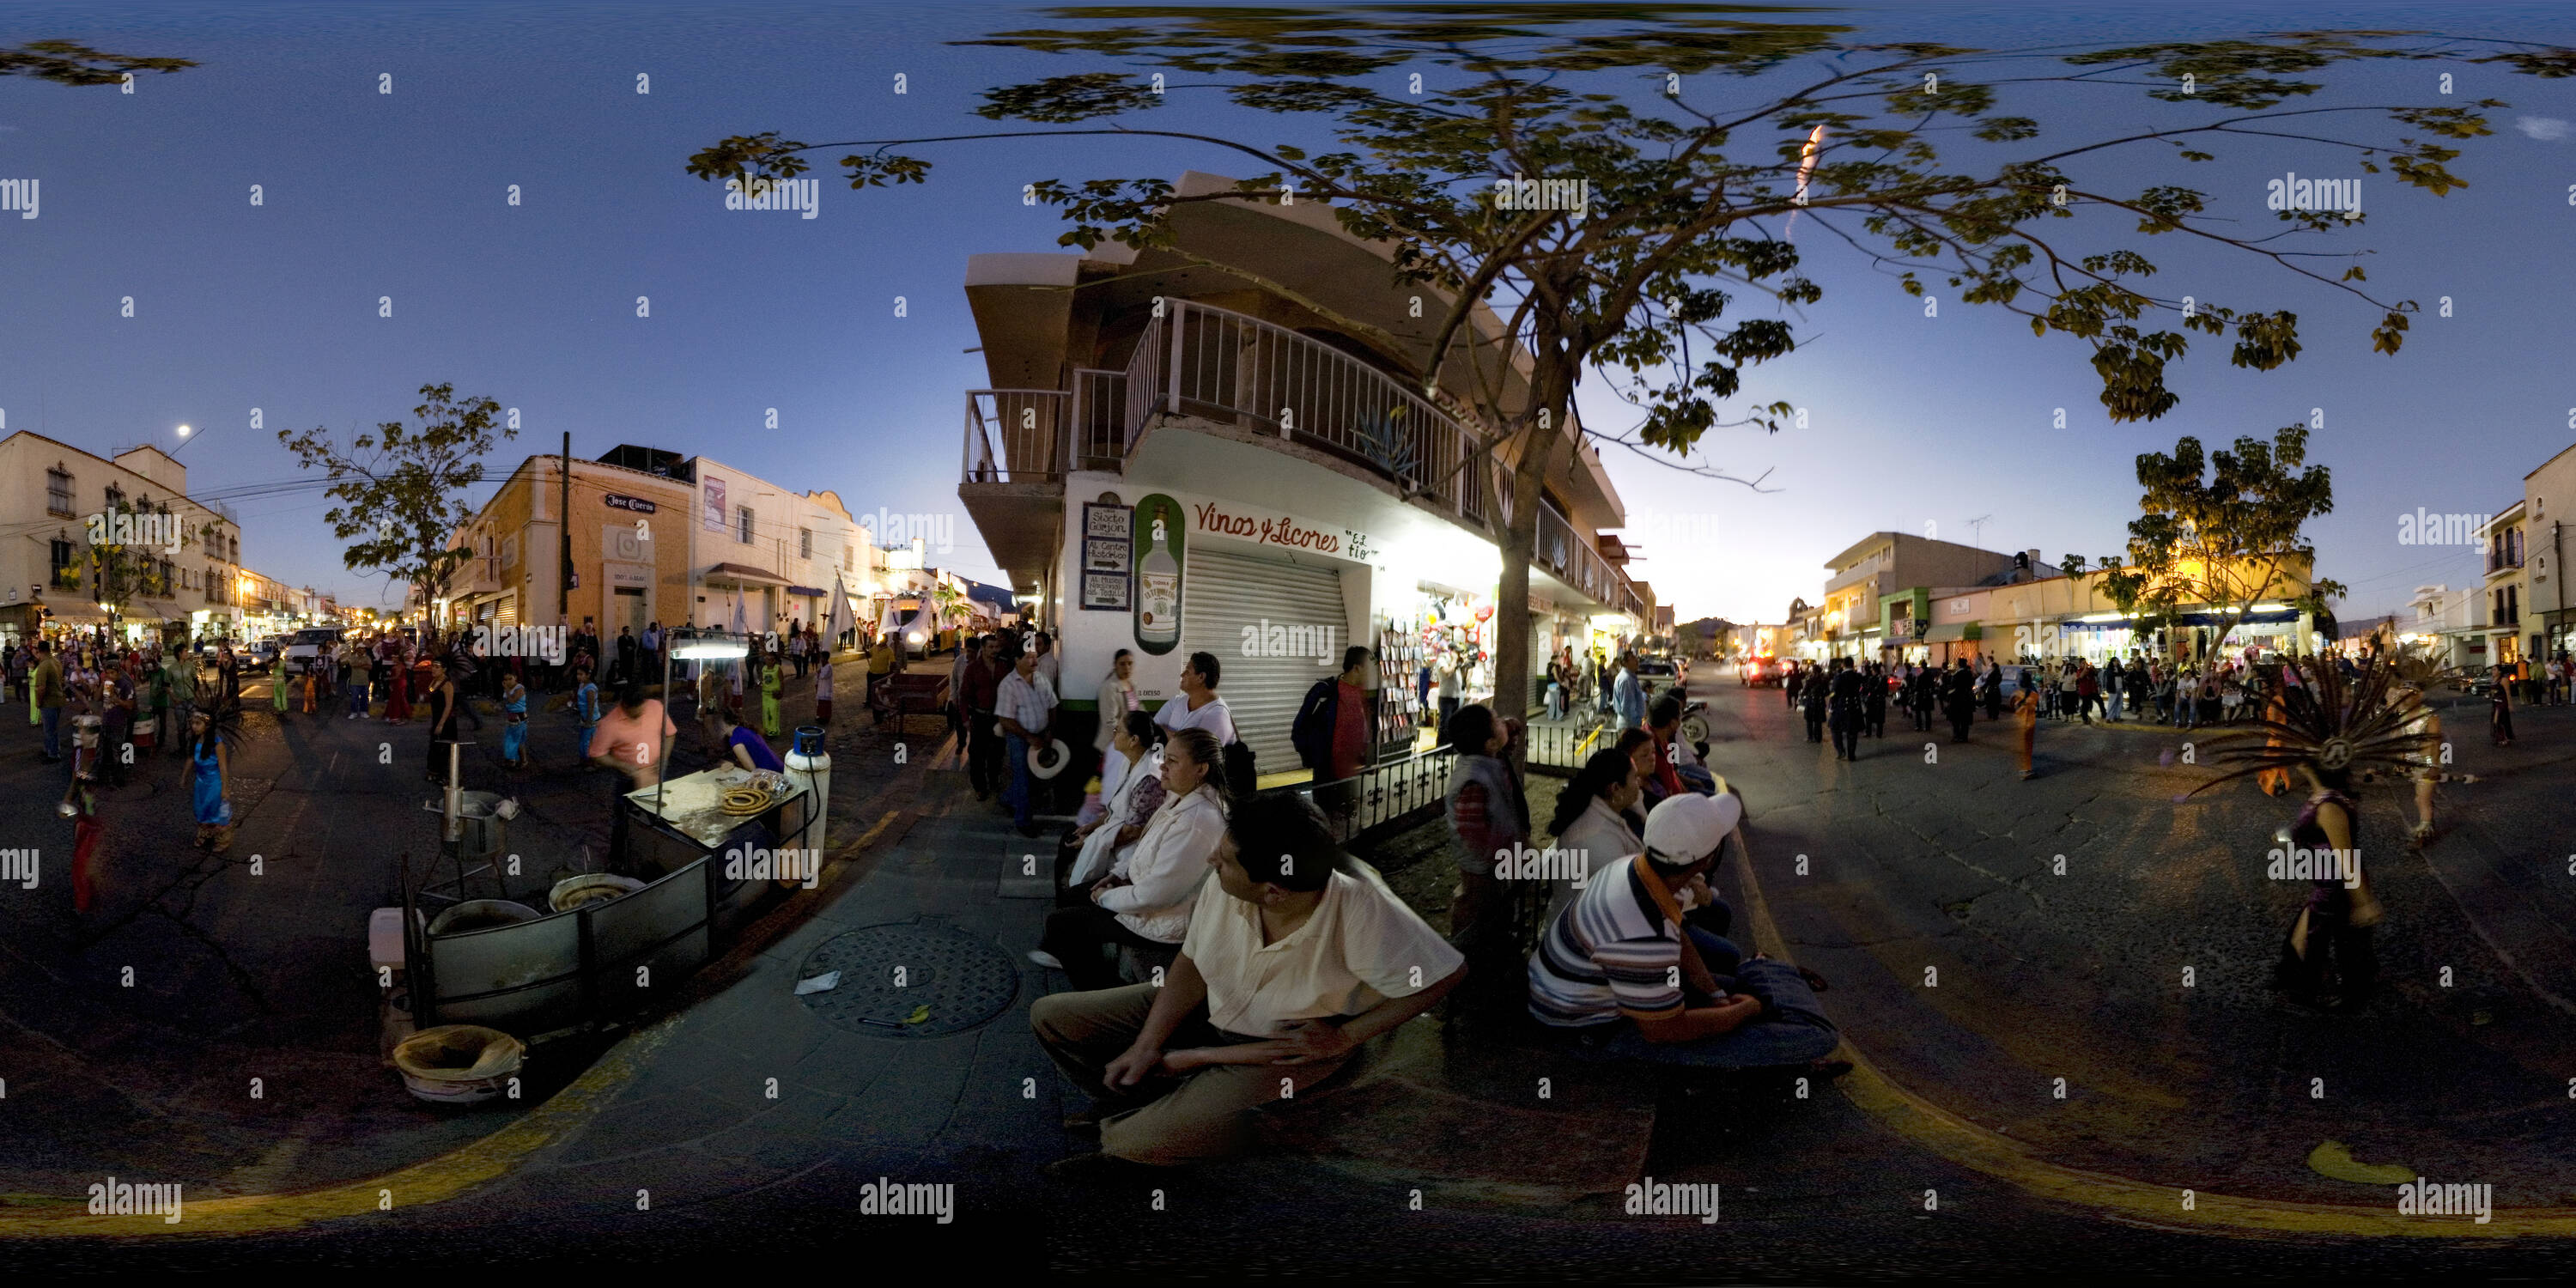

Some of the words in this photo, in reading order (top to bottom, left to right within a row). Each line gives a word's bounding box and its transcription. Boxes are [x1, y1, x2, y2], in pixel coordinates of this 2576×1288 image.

[608, 495, 627, 507] Jose
[1093, 512, 1125, 524] Sixto
[1194, 501, 1257, 536] Vinos
[1261, 518, 1273, 544] y
[1270, 517, 1340, 553] Licores
[1101, 542, 1127, 551] Centro
